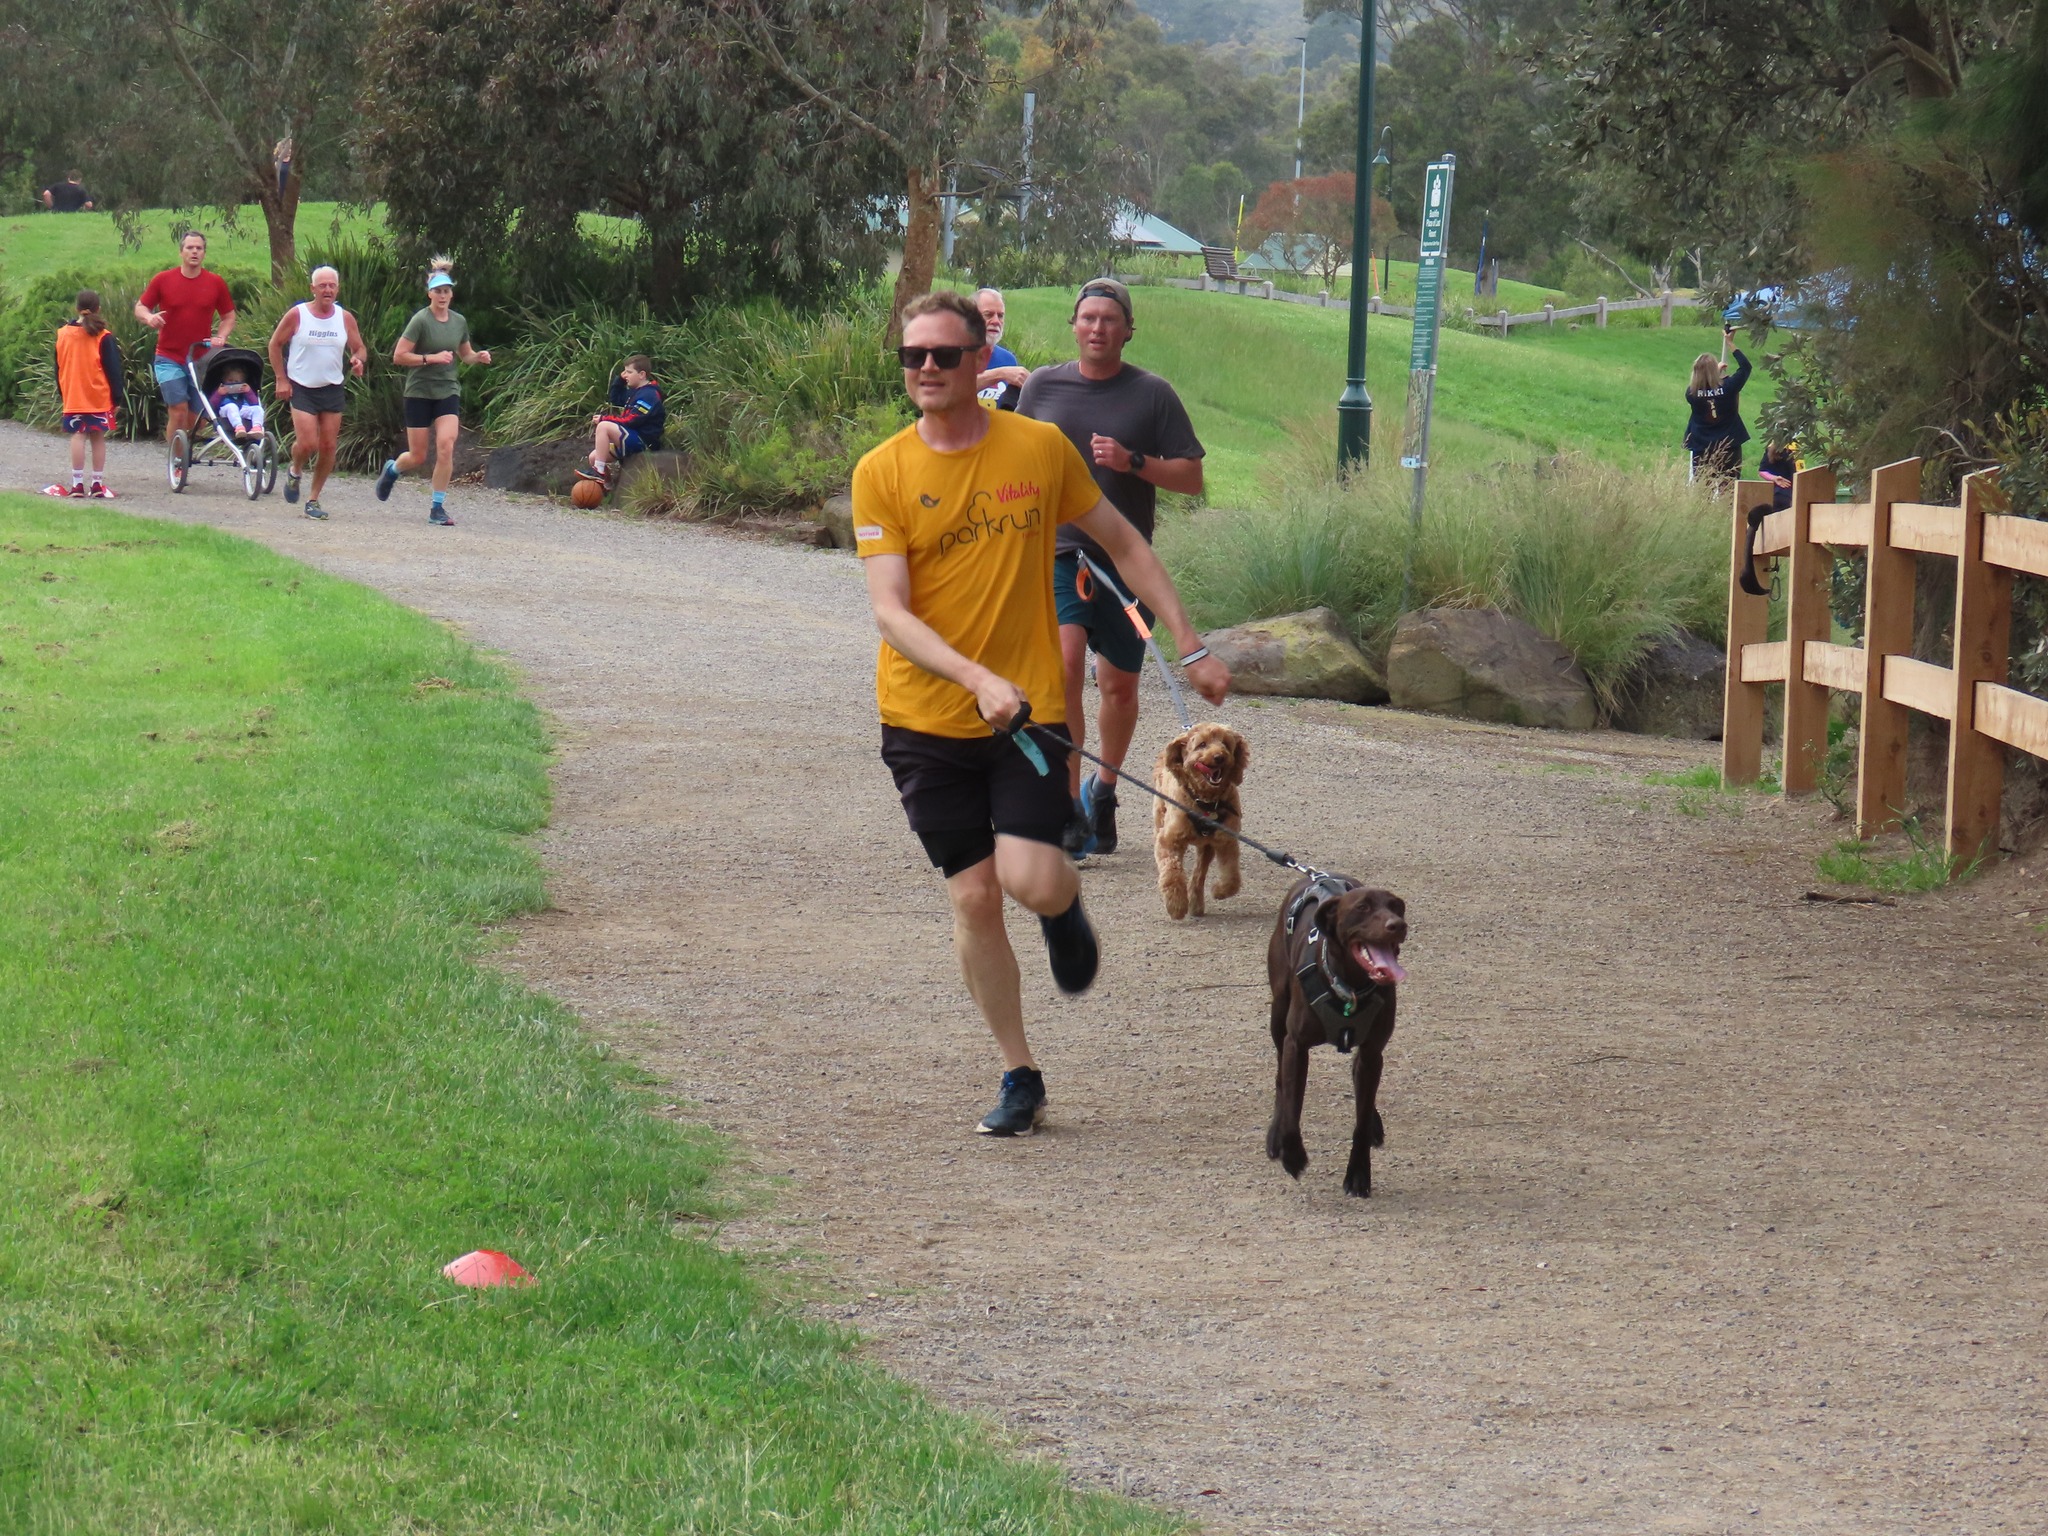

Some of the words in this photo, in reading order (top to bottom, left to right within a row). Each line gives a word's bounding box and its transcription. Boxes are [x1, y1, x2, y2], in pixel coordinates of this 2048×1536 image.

[1697, 387, 1724, 397] RIKKI
[996, 481, 1041, 503] Vitality
[939, 505, 1041, 557] parkrun
